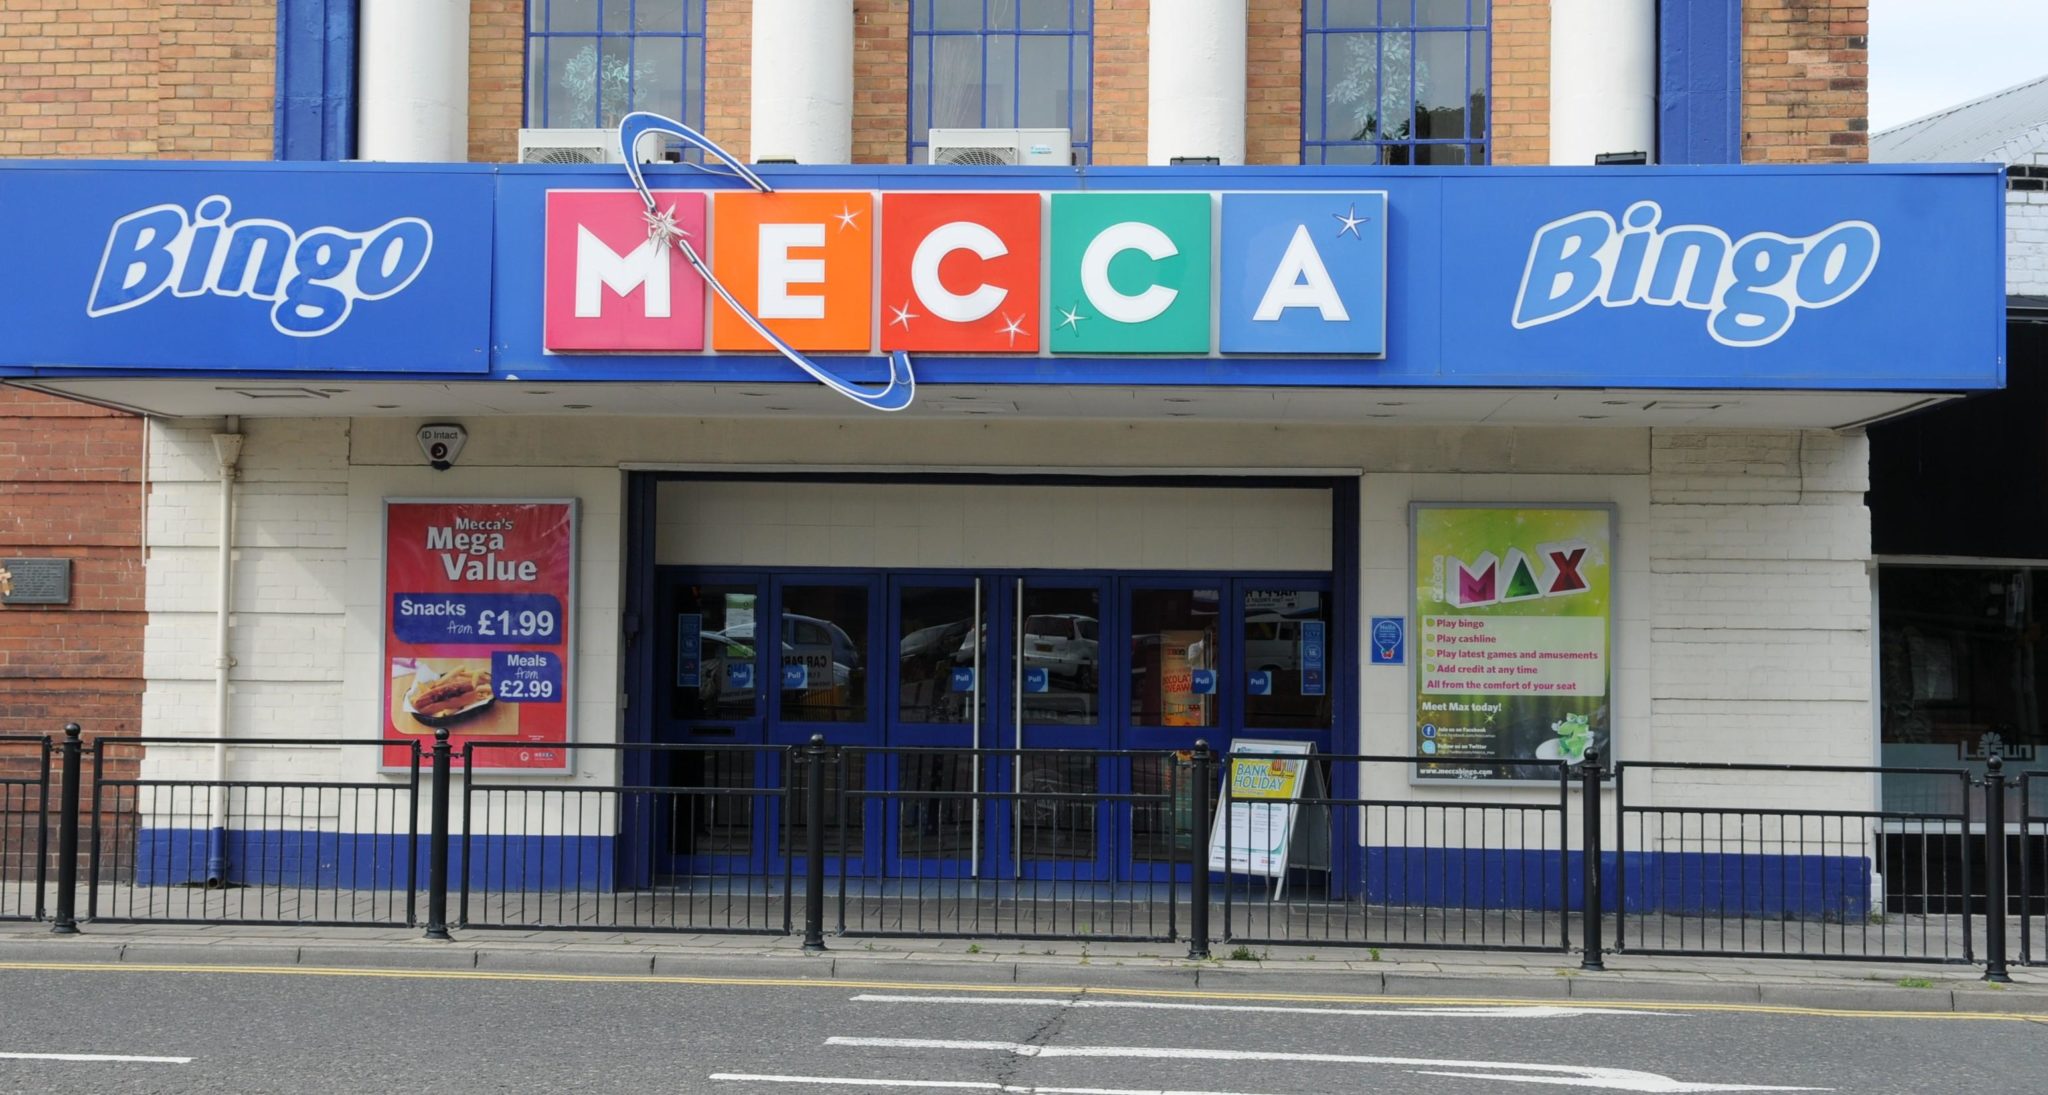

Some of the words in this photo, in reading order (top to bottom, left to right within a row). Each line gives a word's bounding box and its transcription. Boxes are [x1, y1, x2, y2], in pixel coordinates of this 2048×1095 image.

[86, 194, 434, 337] Bingo
[574, 221, 1351, 323] MECCA
[1511, 200, 1881, 347] Bingo
[422, 430, 432, 440] ID
[433, 430, 458, 440] Intact
[455, 517, 513, 531] Mecca's
[427, 527, 504, 554] Mega
[441, 553, 538, 582] Value
[1448, 543, 1591, 608] MAX
[401, 600, 466, 617] Snacks
[447, 621, 473, 635] from
[478, 610, 554, 636] £1.99
[1436, 619, 1456, 630] Play
[1458, 619, 1484, 630] bingo
[1436, 634, 1456, 645] Play
[1458, 634, 1496, 644] cashline
[507, 654, 547, 668] Meals
[1436, 649, 1456, 660] Play
[1458, 649, 1486, 659] latest
[1487, 652, 1518, 661] games
[1519, 650, 1537, 660] and
[1538, 650, 1598, 660] amusements
[514, 667, 539, 680] from
[733, 670, 747, 680] Pull
[787, 670, 801, 680] Pull
[955, 672, 969, 682] Pull
[1437, 665, 1455, 674] Add
[1457, 665, 1484, 674] credit
[1486, 666, 1496, 674] at
[1497, 667, 1514, 676] any
[1516, 665, 1538, 675] time
[1027, 674, 1041, 684] Pull
[1195, 675, 1209, 685] Pull
[1250, 677, 1264, 686] Pull
[500, 680, 553, 698] £2.99
[1427, 680, 1439, 690] All
[1441, 680, 1464, 690] from
[1466, 681, 1481, 690] the
[1483, 681, 1520, 690] comfort
[1521, 681, 1532, 690] of
[1533, 683, 1554, 692] your
[1556, 682, 1576, 691] seat
[1422, 702, 1447, 712] Meet
[1449, 702, 1469, 712] Max
[1471, 702, 1502, 713] today!
[1236, 763, 1269, 777] BANK
[1420, 767, 1493, 777] www.meccabingo.com
[1233, 775, 1285, 791] HOLIDAY
